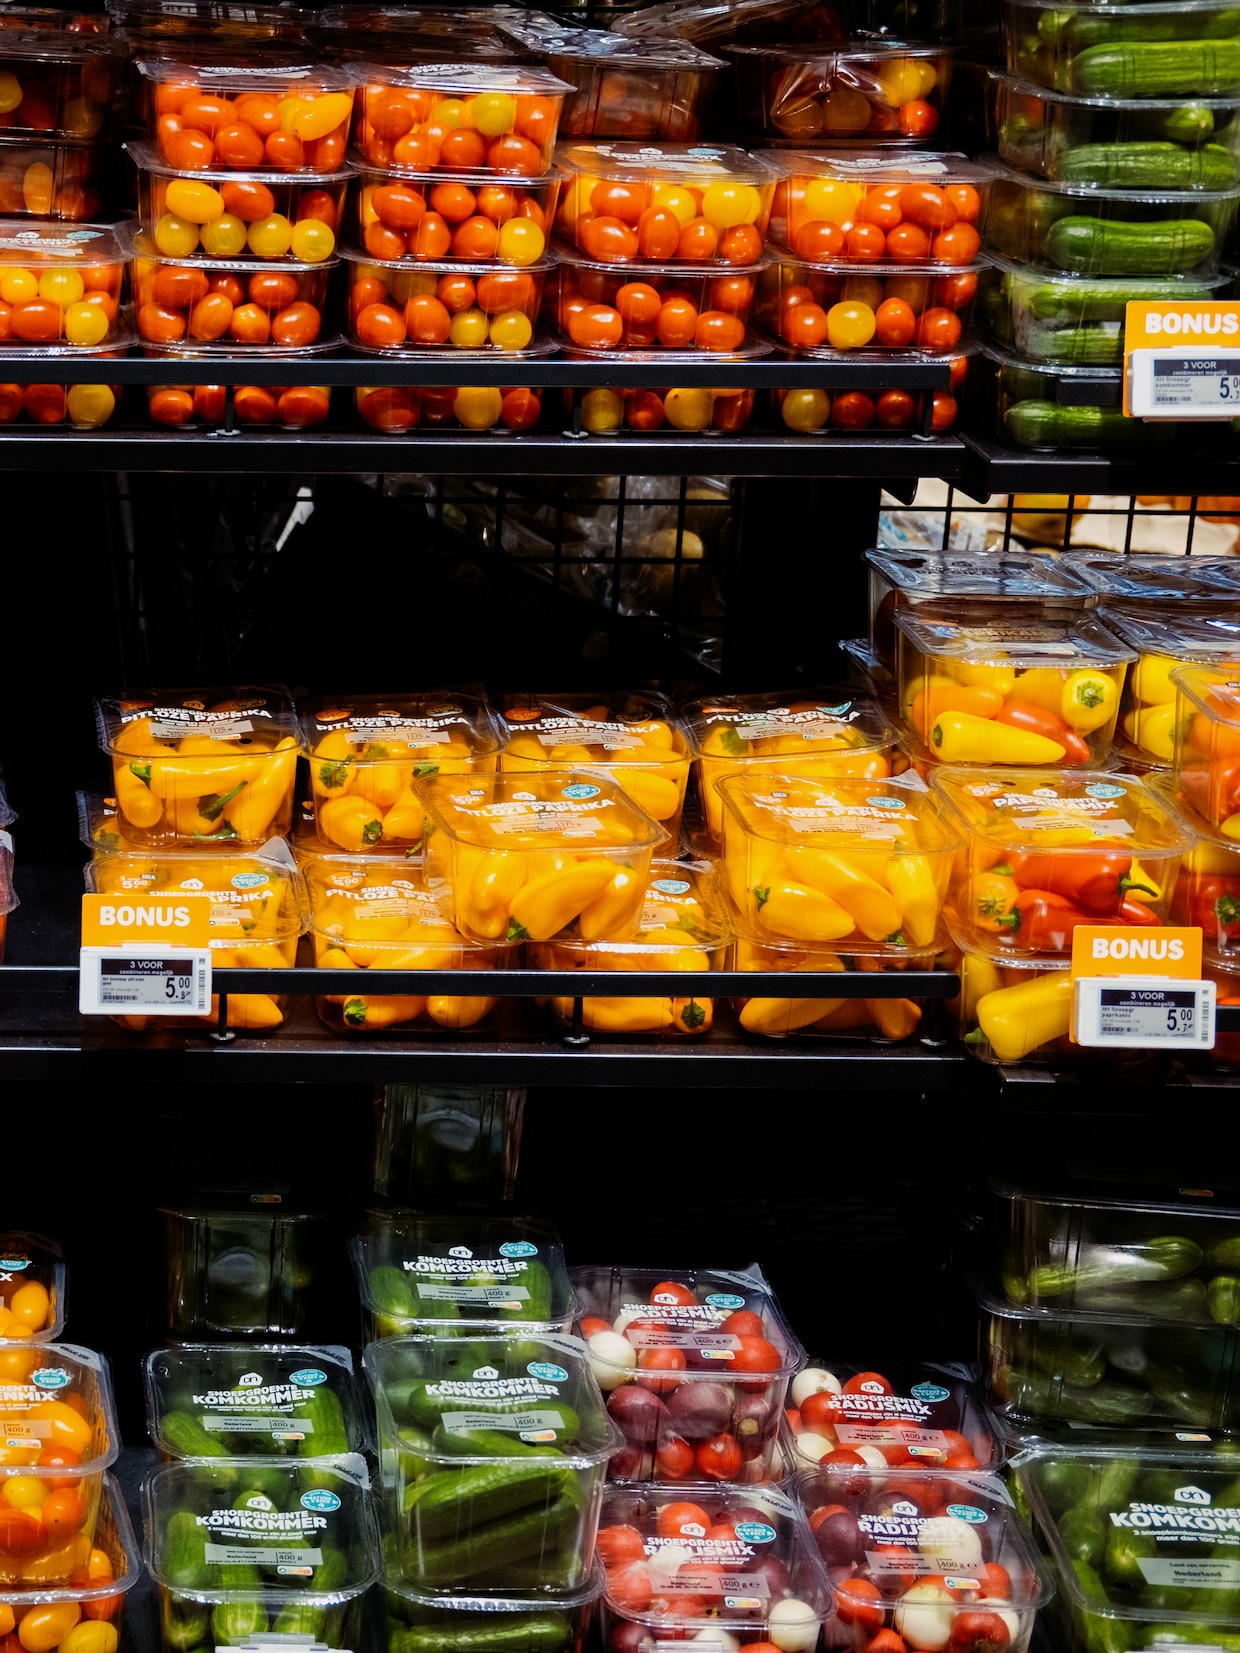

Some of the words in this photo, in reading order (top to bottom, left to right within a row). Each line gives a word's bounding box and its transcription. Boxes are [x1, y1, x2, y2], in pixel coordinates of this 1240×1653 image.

[1145, 313, 1239, 334] BONUS
[121, 710, 190, 723] PITLOZE
[195, 709, 272, 722] PAPRIKA
[316, 720, 387, 731] PITLOZE
[391, 717, 472, 728] PAPRIKA
[508, 720, 577, 731] PITLOZE
[533, 799, 616, 813] PAPRIKA
[210, 890, 274, 903] APRIKA
[326, 889, 399, 900] PITLOZE
[100, 906, 190, 926] BONUS
[1092, 938, 1184, 960] BONUS
[130, 961, 135, 969] 3
[138, 961, 163, 969] VOOR
[1138, 992, 1164, 1000] VOOR
[403, 1261, 528, 1273] KOMKOMMER
[417, 1255, 509, 1267] SNOEPGROENTE
[623, 1303, 717, 1312] SNOEPGROENTE
[620, 1309, 727, 1321] RADIJSMIX
[440, 1378, 539, 1389] SNOEPGROENTE
[208, 1384, 298, 1398] SNOEPGROENTE
[425, 1384, 560, 1398] KOMKOMMER
[192, 1390, 316, 1405] KOMKOMMER
[830, 1394, 923, 1406] SNOEPGROENTE
[828, 1401, 932, 1415] RADIJSMIX
[212, 1510, 308, 1519] SNOEPGROENTE
[196, 1515, 328, 1530] KOMKOMMER
[858, 1521, 967, 1536] RADIJSMIX
[647, 1537, 746, 1548] SNOEPGROENTE
[643, 1545, 756, 1556] RADIJSMIX
[940, 1560, 957, 1568] 400
[723, 1580, 740, 1588] 400
